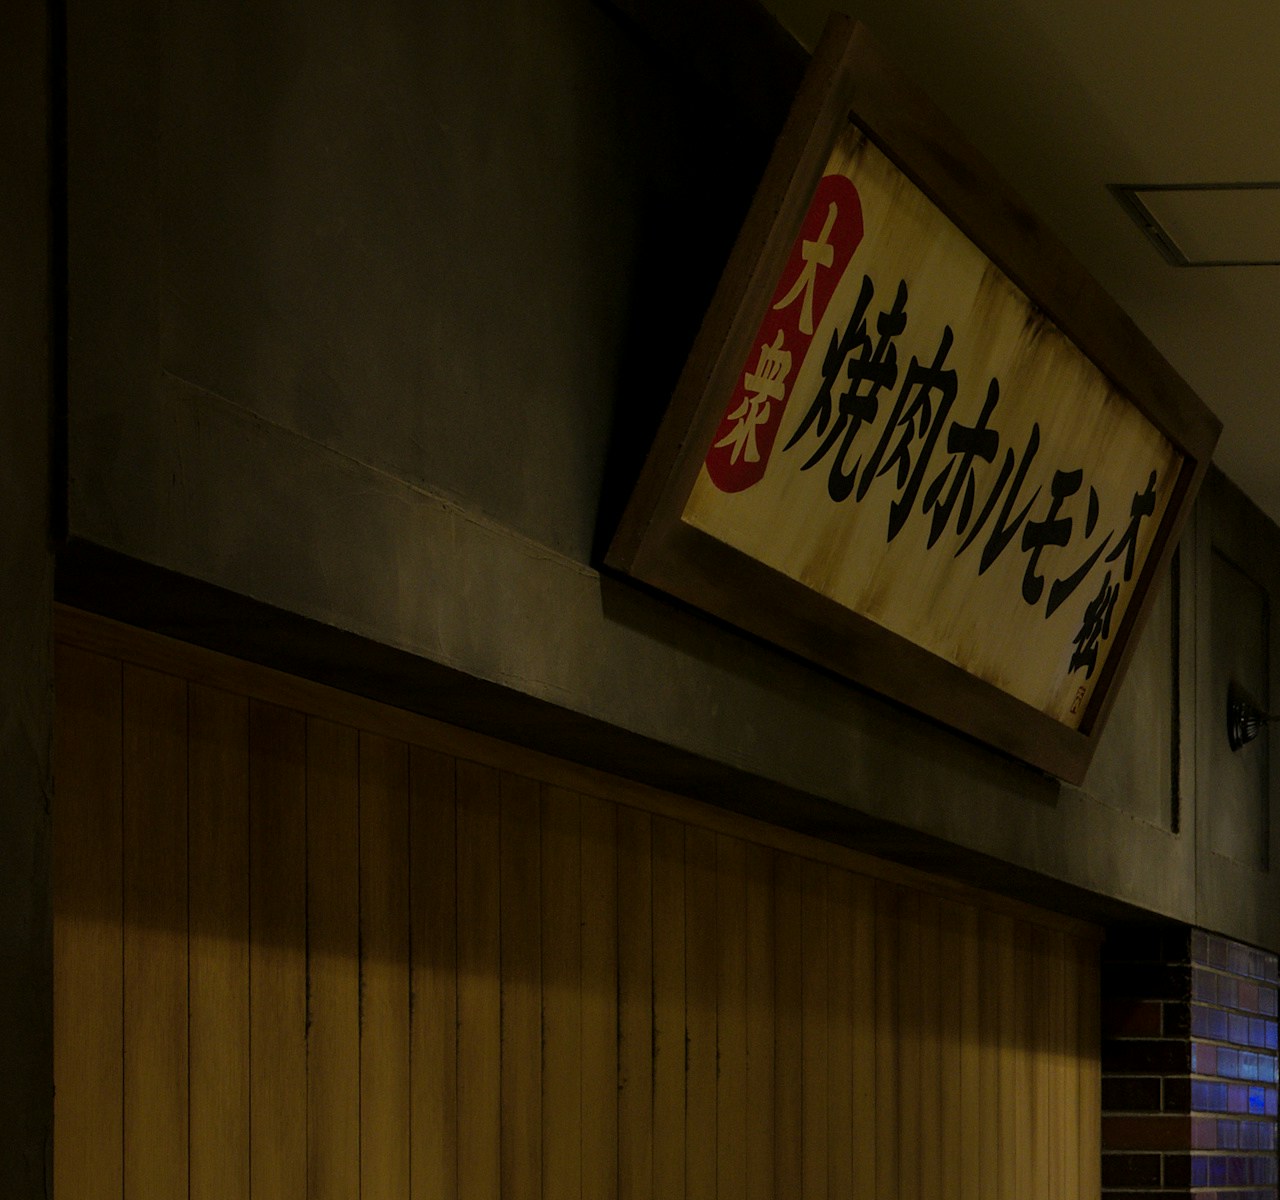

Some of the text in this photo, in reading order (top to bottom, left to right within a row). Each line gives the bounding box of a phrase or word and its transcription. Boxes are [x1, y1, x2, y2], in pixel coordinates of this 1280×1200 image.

[713, 202, 838, 465] 大衆
[783, 274, 1117, 620] 焼肉ホルモン
